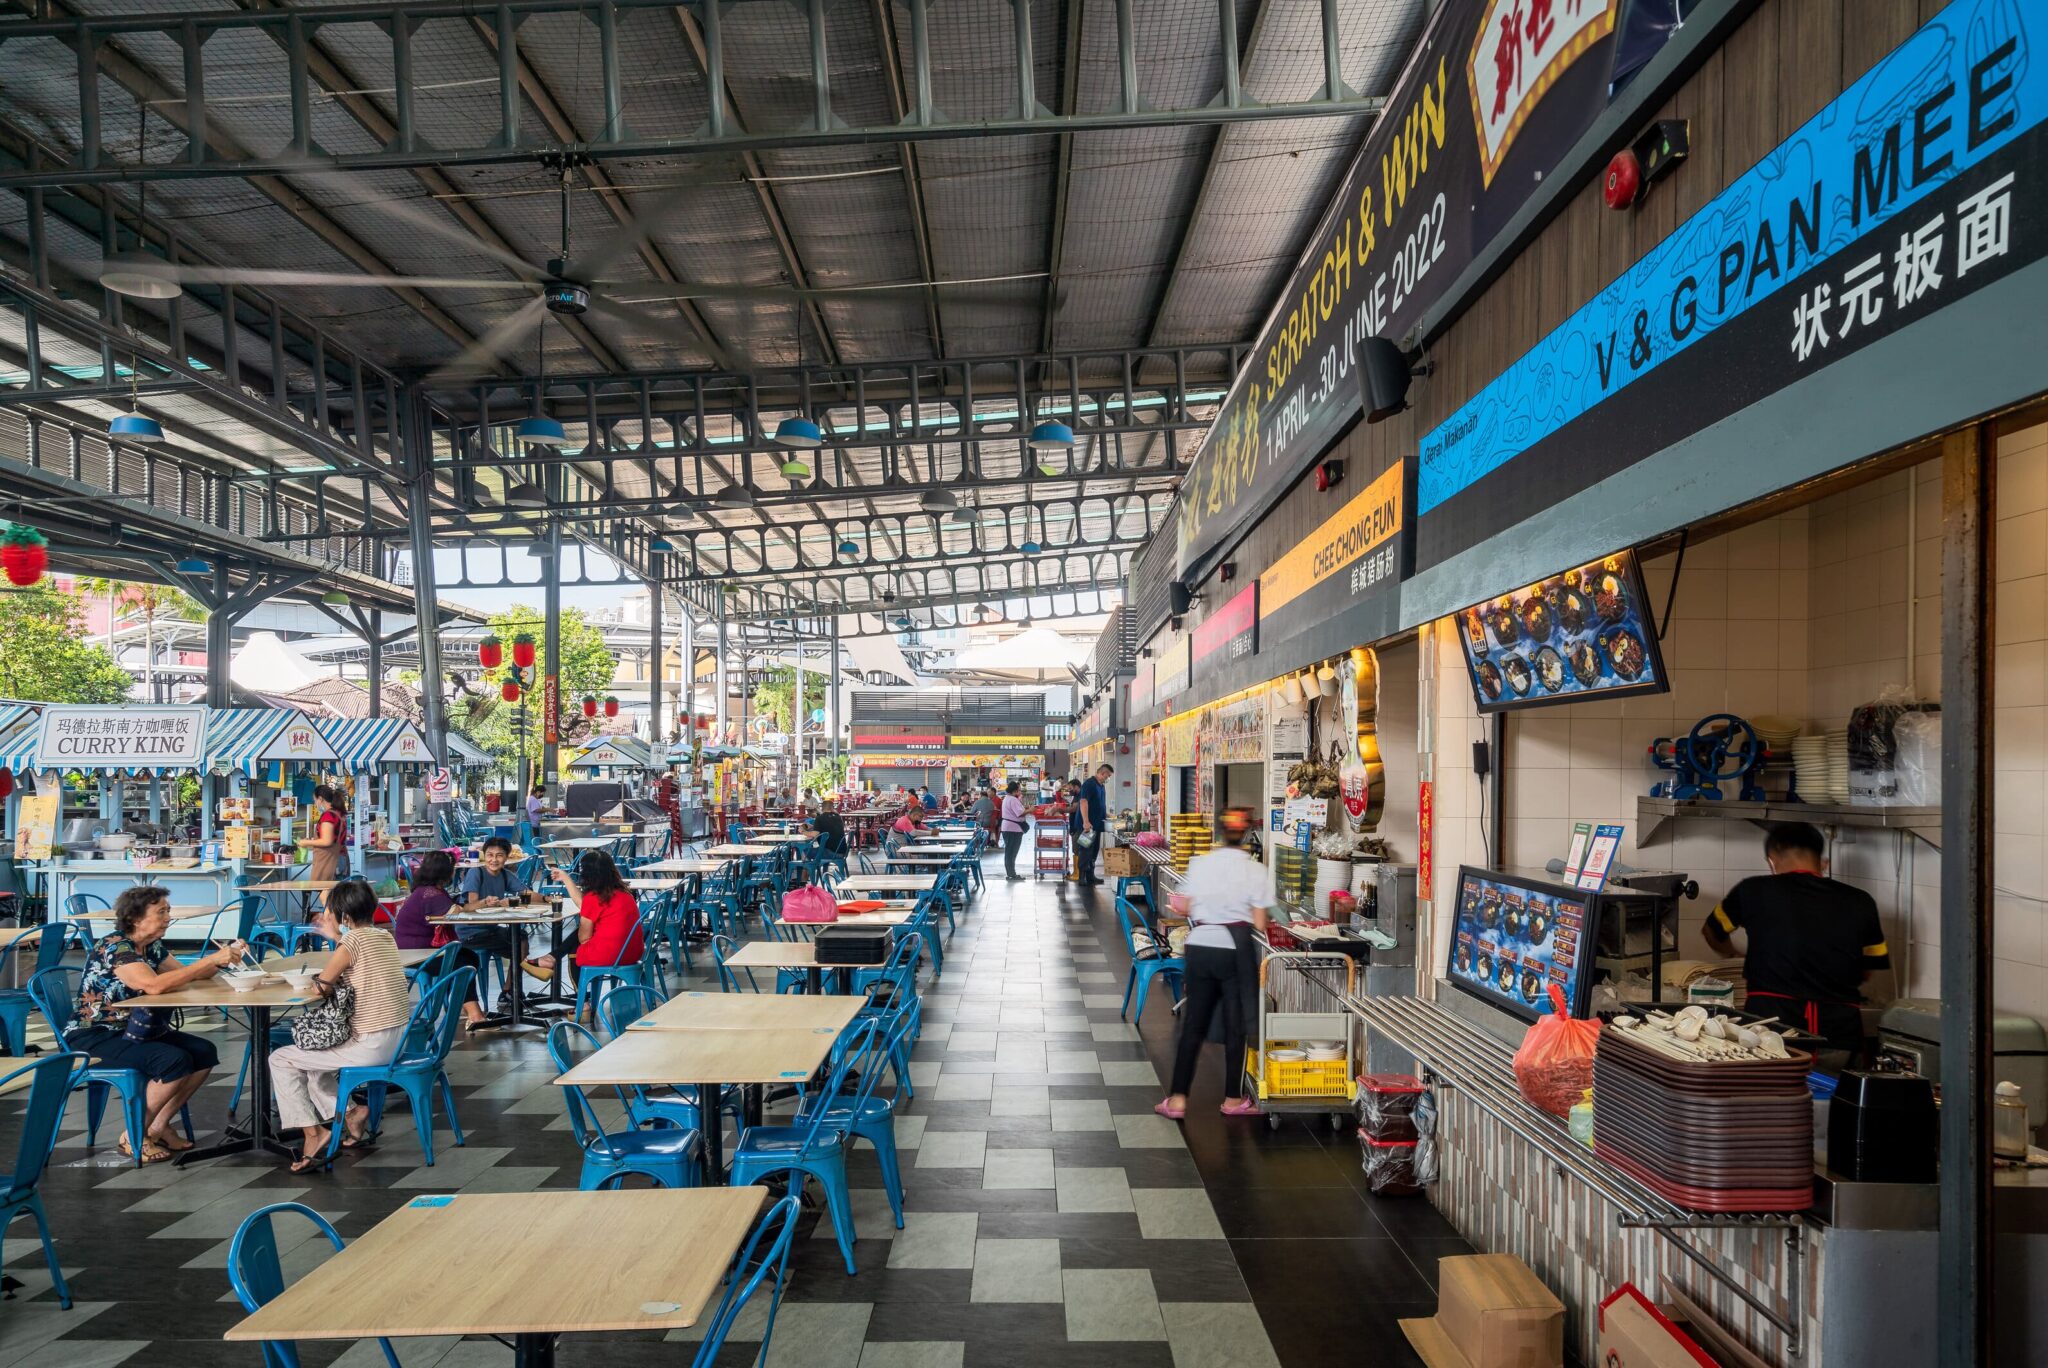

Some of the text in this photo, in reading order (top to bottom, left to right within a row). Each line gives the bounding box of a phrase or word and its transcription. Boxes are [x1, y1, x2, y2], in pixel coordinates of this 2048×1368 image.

[1491, 0, 1581, 125] 新世
[1267, 55, 1445, 402] SCRATCH & WIN
[1596, 35, 2018, 391] V & G PAN MEE
[1791, 171, 2015, 363] 状元板面
[1267, 428, 1273, 465] 1
[1275, 383, 1309, 459] APRIL
[1320, 344, 1336, 403] 30
[1340, 272, 1388, 379] JUNE
[1392, 192, 1446, 314] 2022
[1444, 414, 1478, 449] Makanan
[1313, 496, 1396, 579] CHEE CHONG FUN
[56, 718, 190, 735] 玛德拉斯南方咖喱饭
[57, 736, 185, 754] CURRY KING
[292, 731, 310, 746] 新世界
